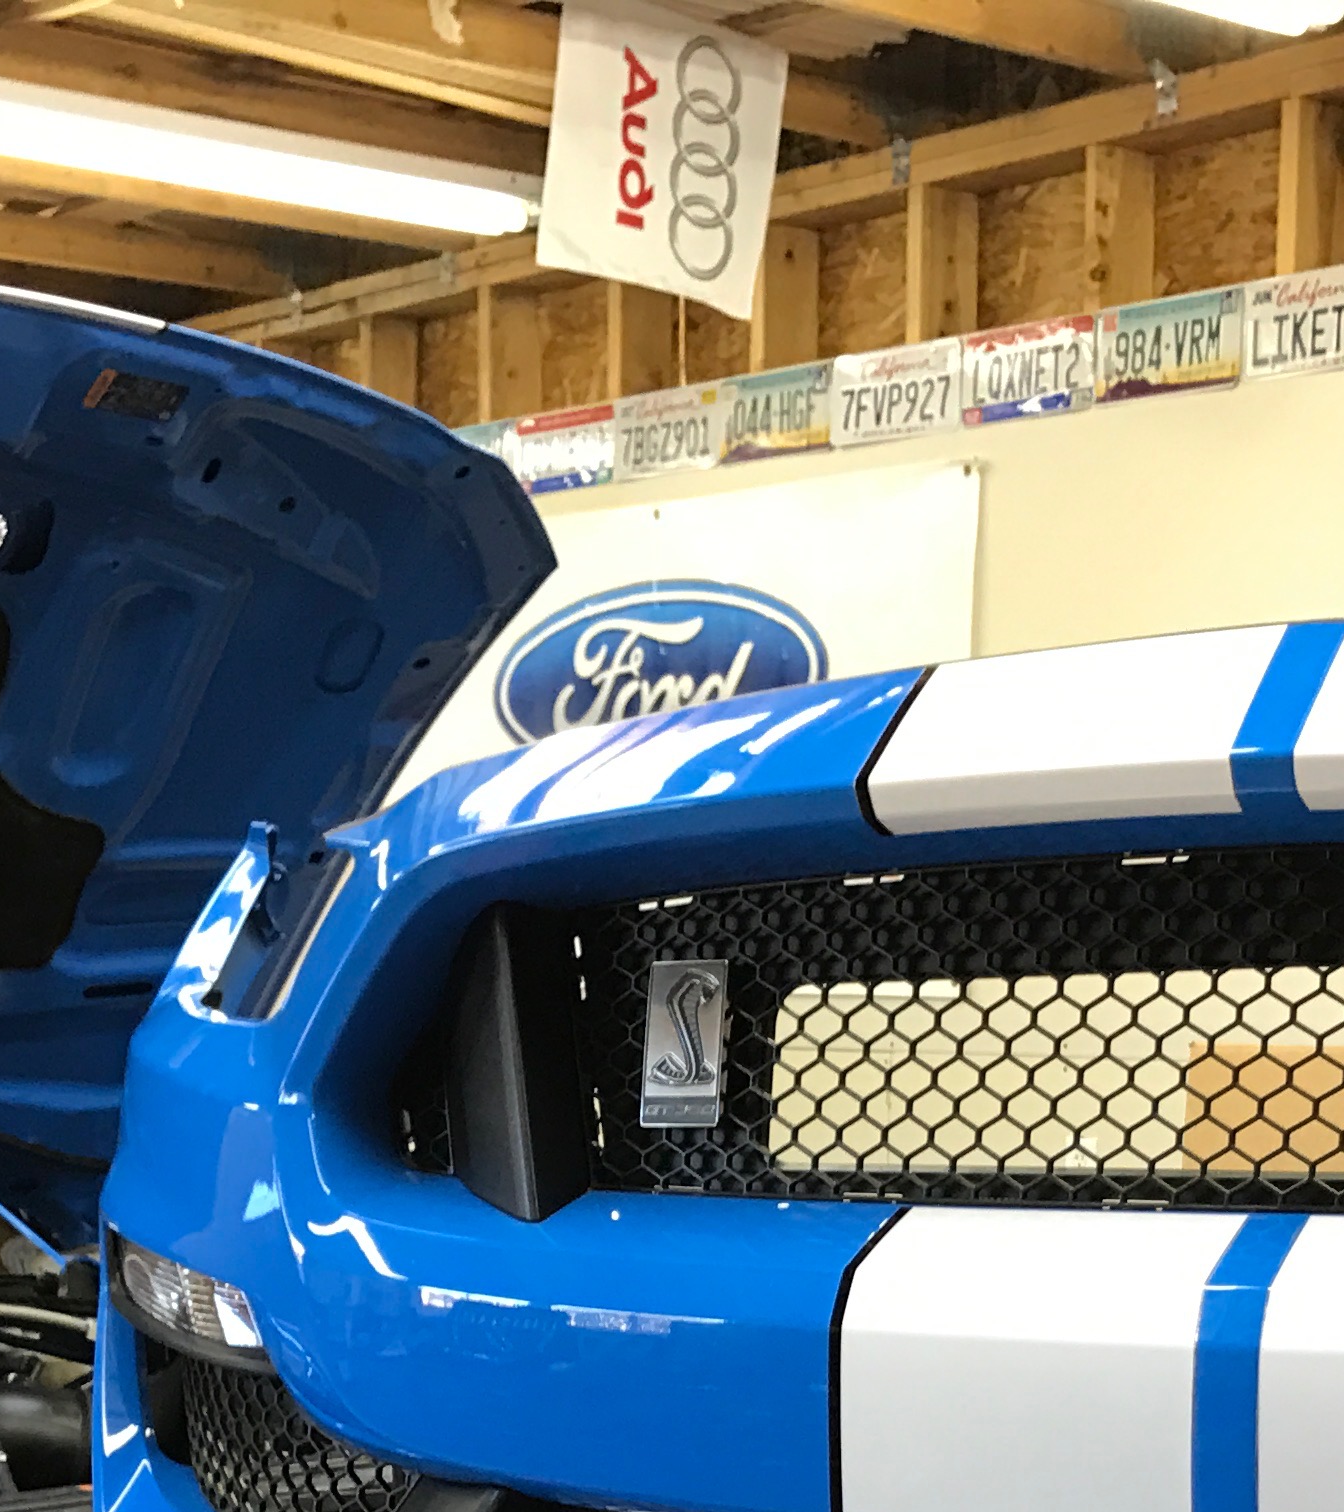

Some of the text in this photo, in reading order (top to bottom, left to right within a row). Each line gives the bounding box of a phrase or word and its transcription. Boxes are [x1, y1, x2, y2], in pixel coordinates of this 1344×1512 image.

[615, 45, 658, 231] Audi
[841, 375, 951, 430] 7FVP927
[553, 616, 754, 732] Ford
